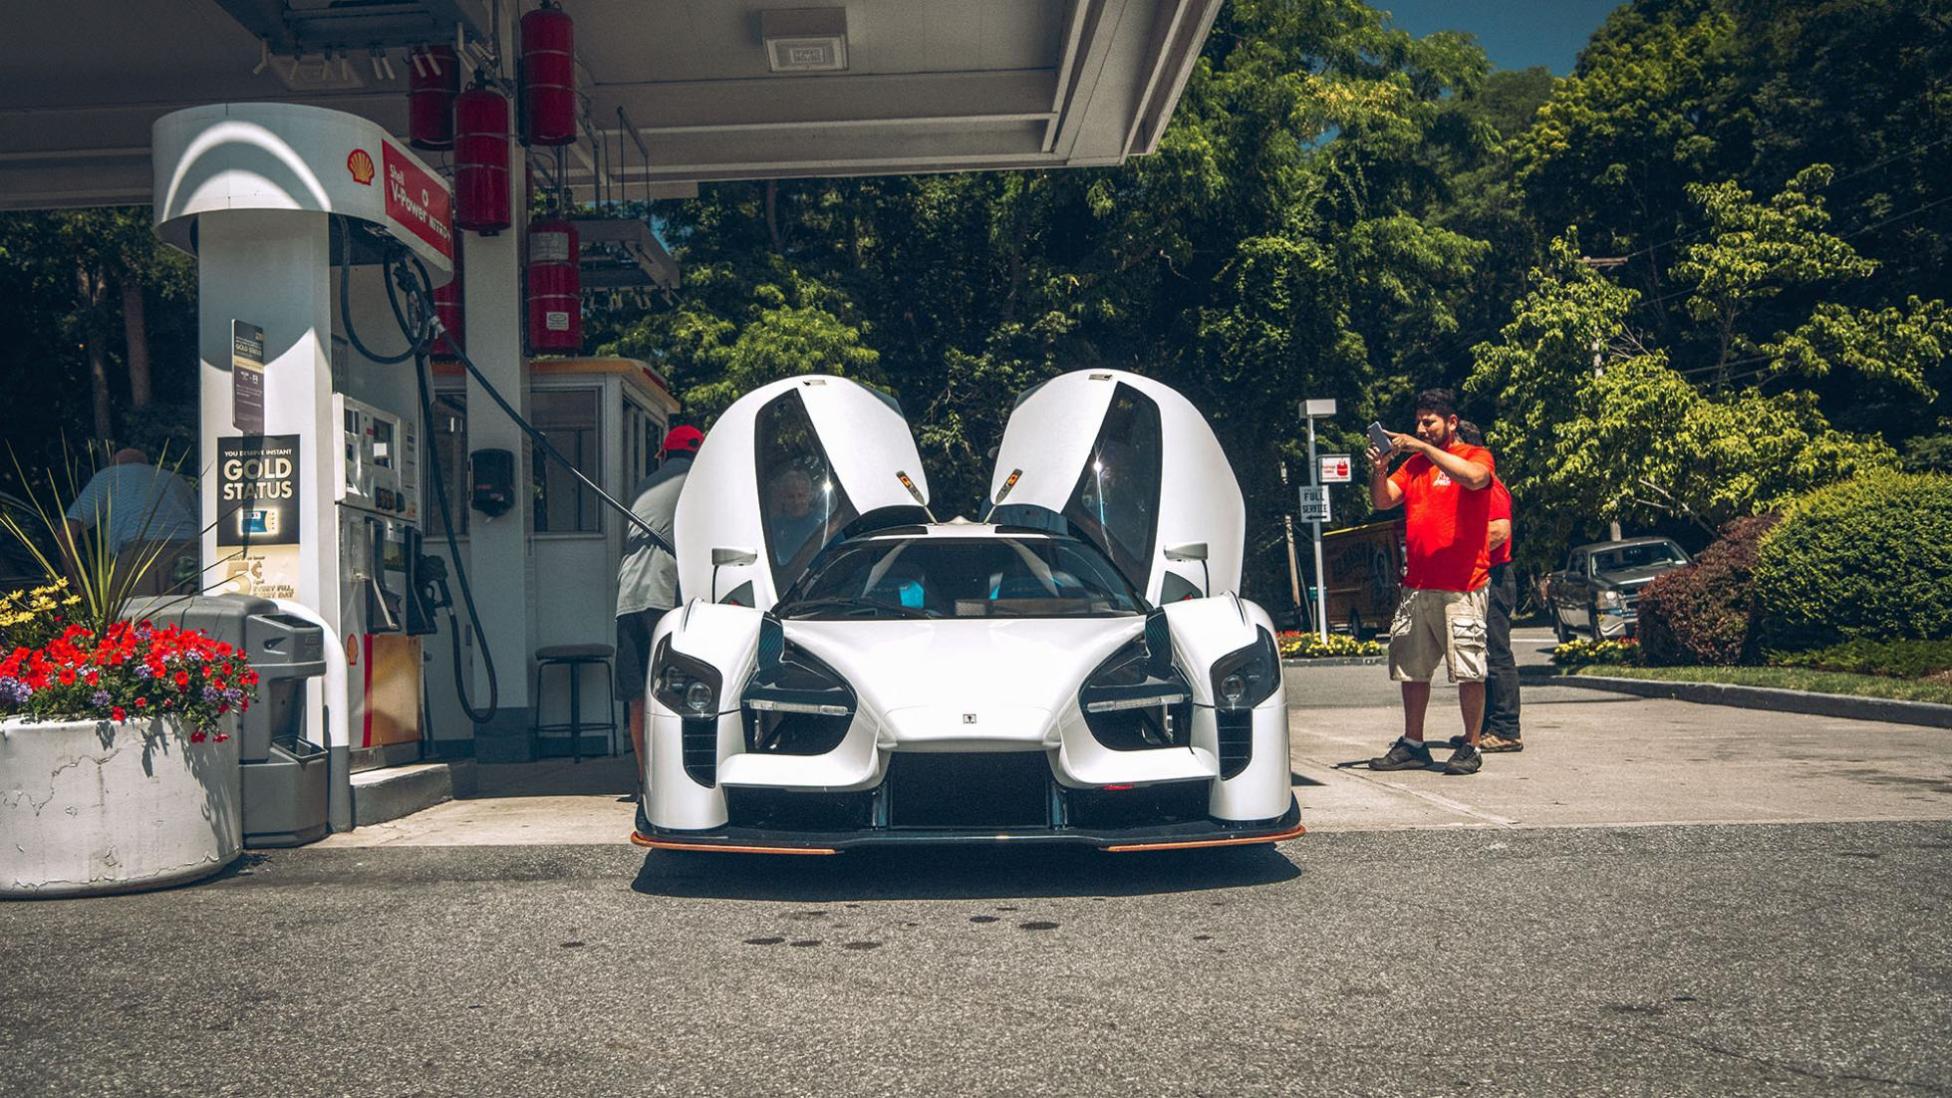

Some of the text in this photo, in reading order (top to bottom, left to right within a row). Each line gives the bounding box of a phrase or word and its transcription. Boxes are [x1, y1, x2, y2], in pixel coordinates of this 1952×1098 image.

[391, 180, 427, 223] V-Power
[265, 448, 292, 456] INSTANT
[223, 457, 293, 481] GOLD
[223, 480, 293, 500] STATUS
[1304, 492, 1325, 501] FULL
[1303, 504, 1328, 513] SERVICE
